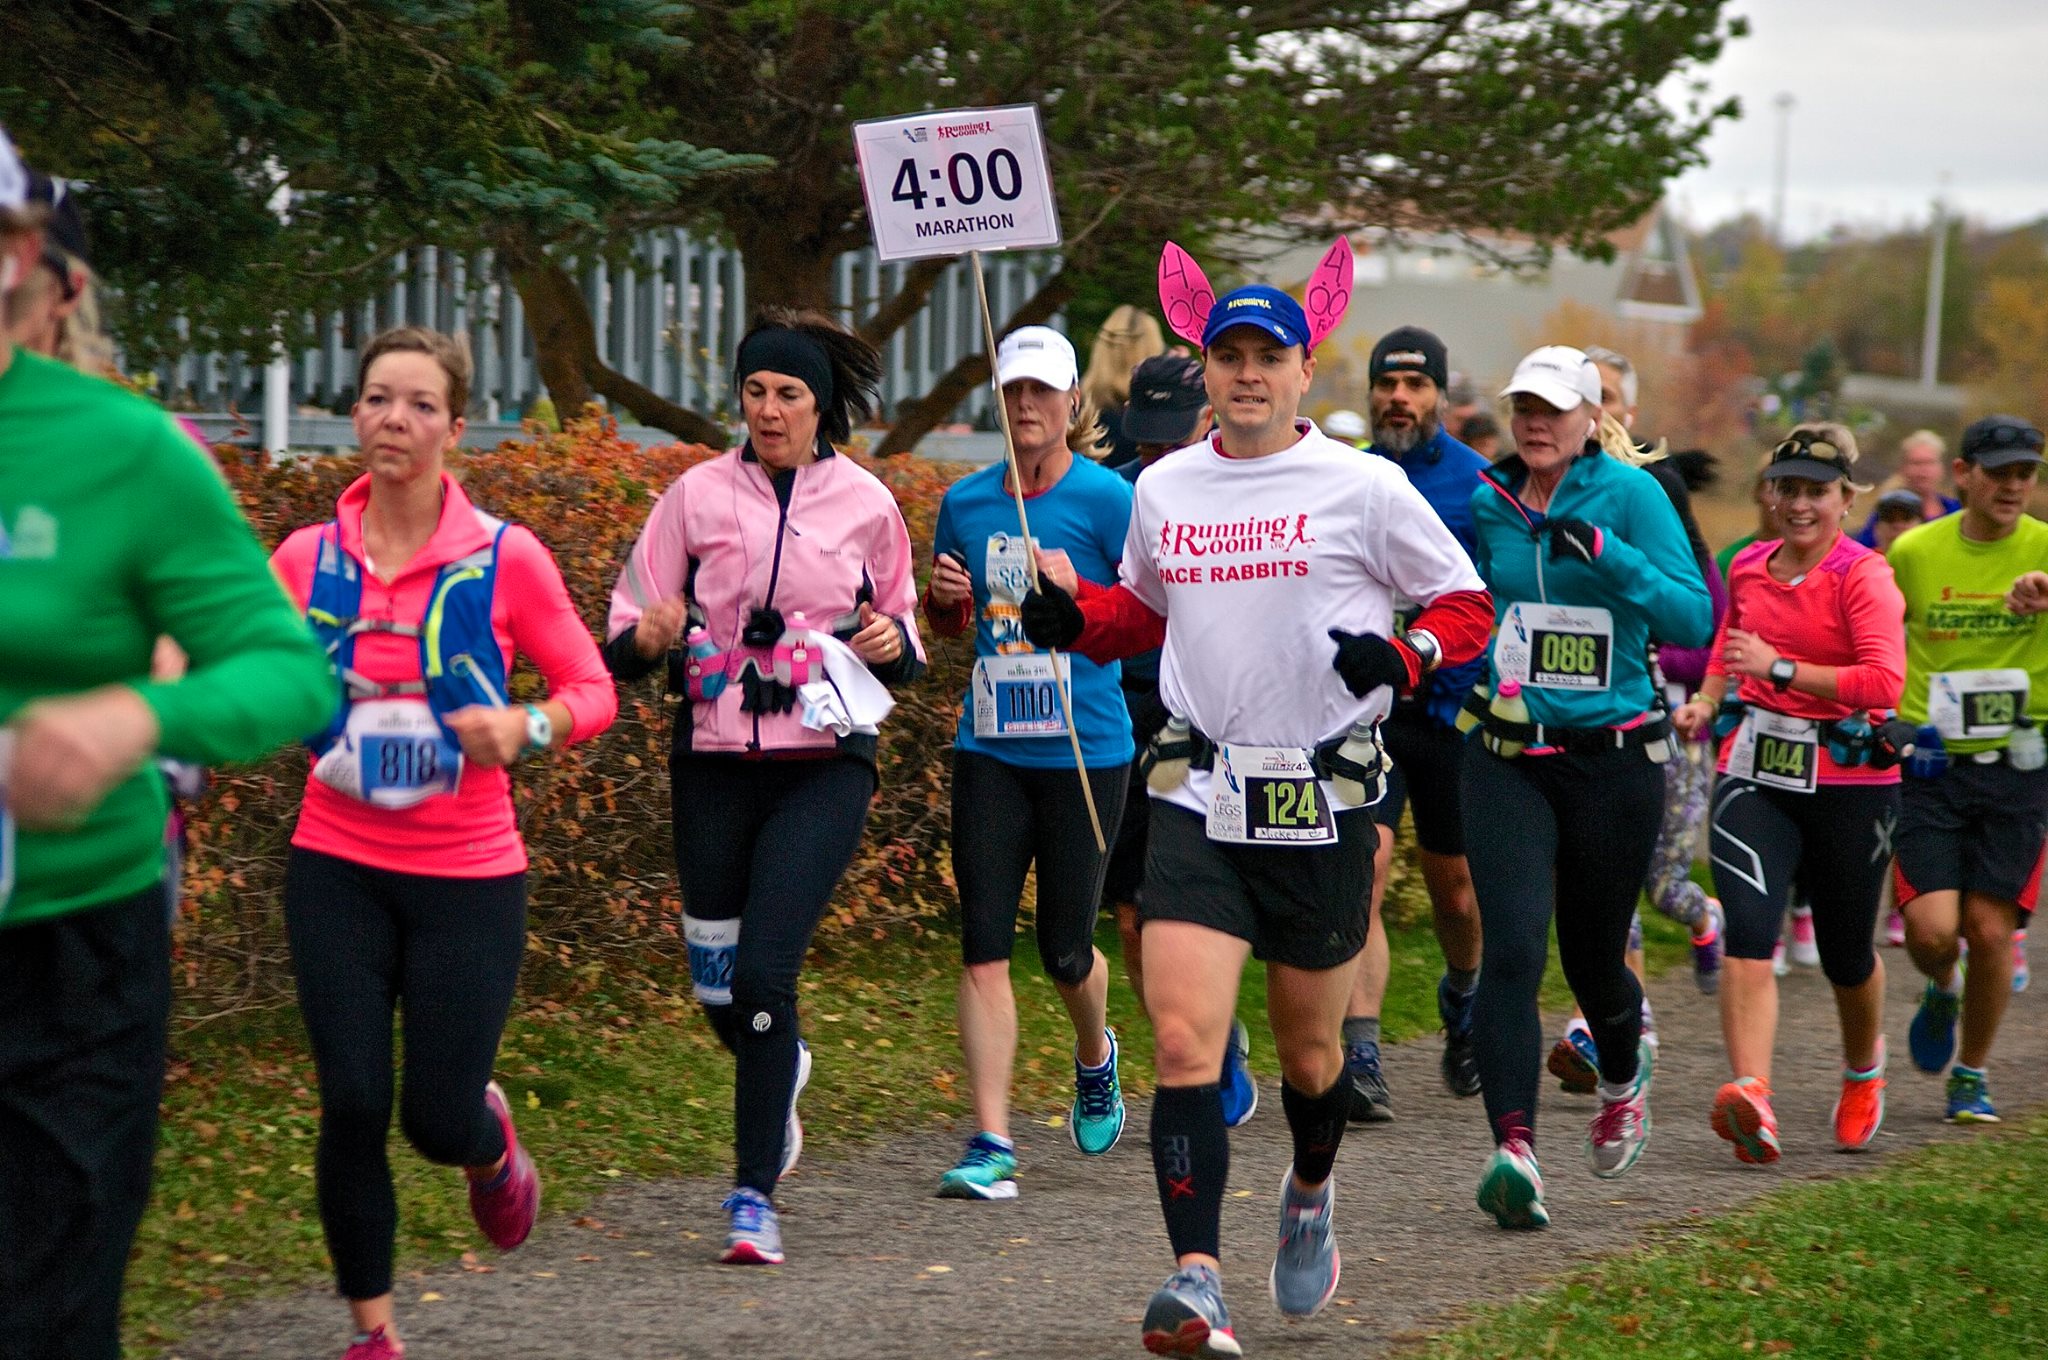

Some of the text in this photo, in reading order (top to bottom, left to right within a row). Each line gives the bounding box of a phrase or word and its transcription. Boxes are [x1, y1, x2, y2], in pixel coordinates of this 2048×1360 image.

[945, 121, 985, 138] Running
[891, 148, 1023, 210] 4:00
[915, 213, 1015, 237] MARATHON
[1173, 515, 1289, 556] Running
[1159, 560, 1309, 585] PACE RABBITS
[1541, 633, 1596, 673] 086
[1008, 682, 1054, 720] 1110
[381, 737, 437, 787] 818
[1762, 738, 1805, 776] 044
[1214, 803, 1242, 816] LEGS
[1263, 781, 1319, 826] 124
